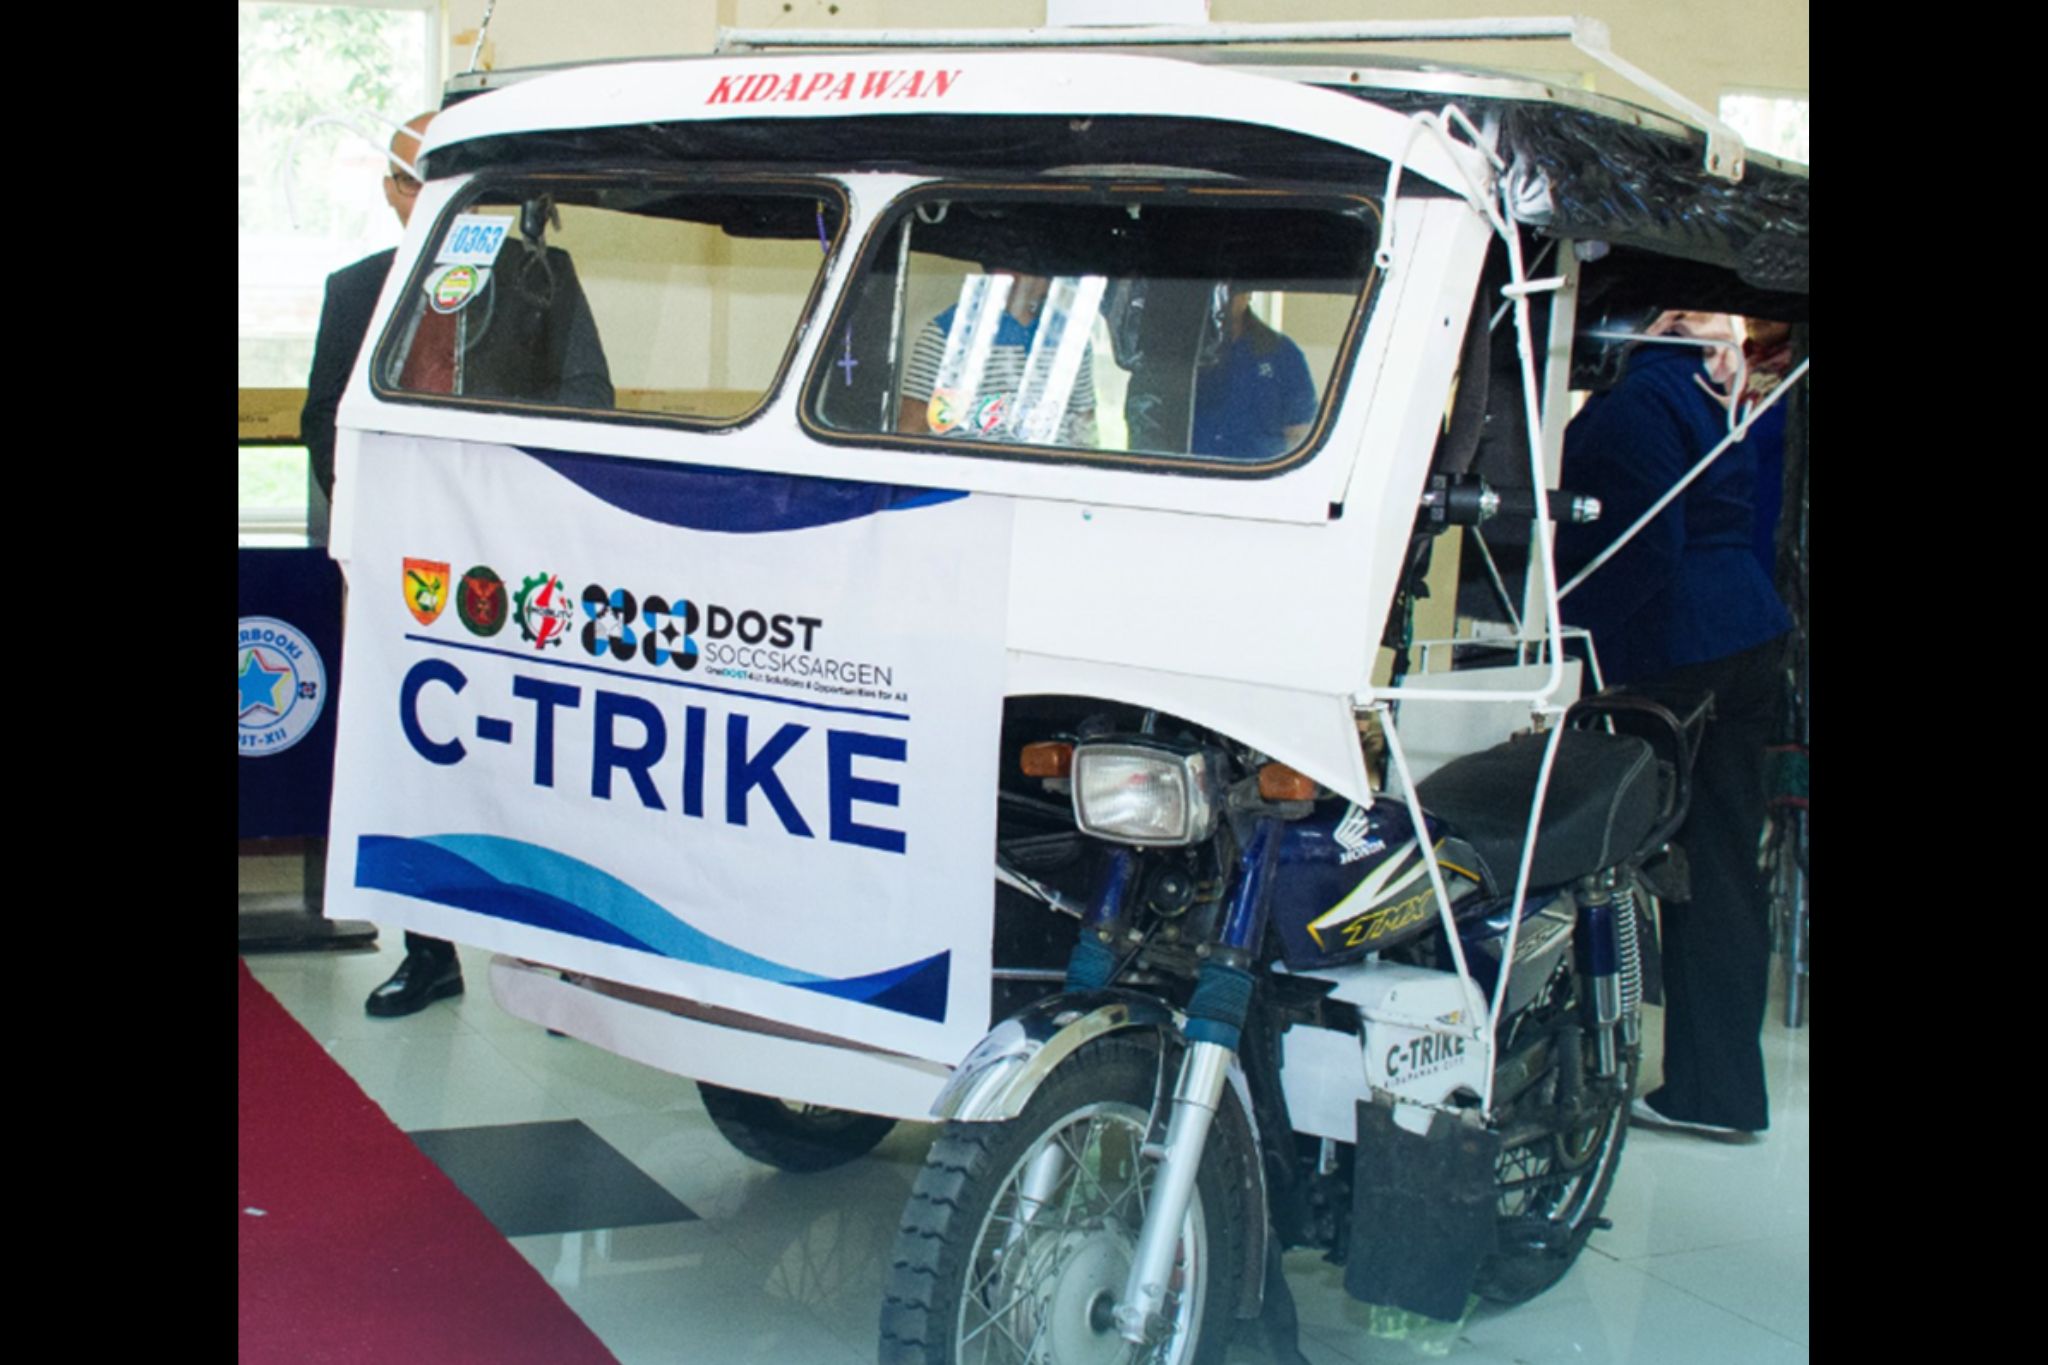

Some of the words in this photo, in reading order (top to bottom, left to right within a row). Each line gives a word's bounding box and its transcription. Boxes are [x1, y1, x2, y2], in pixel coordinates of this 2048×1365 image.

[705, 69, 963, 105] KIDAPAWAN
[452, 224, 504, 254] 0363
[706, 605, 822, 652] DOST
[705, 642, 892, 687] SOCCSKSARGEN
[400, 658, 907, 855] C-TRIKE
[1339, 839, 1387, 865] HONDA
[1386, 1032, 1464, 1077] C-TRIKE
